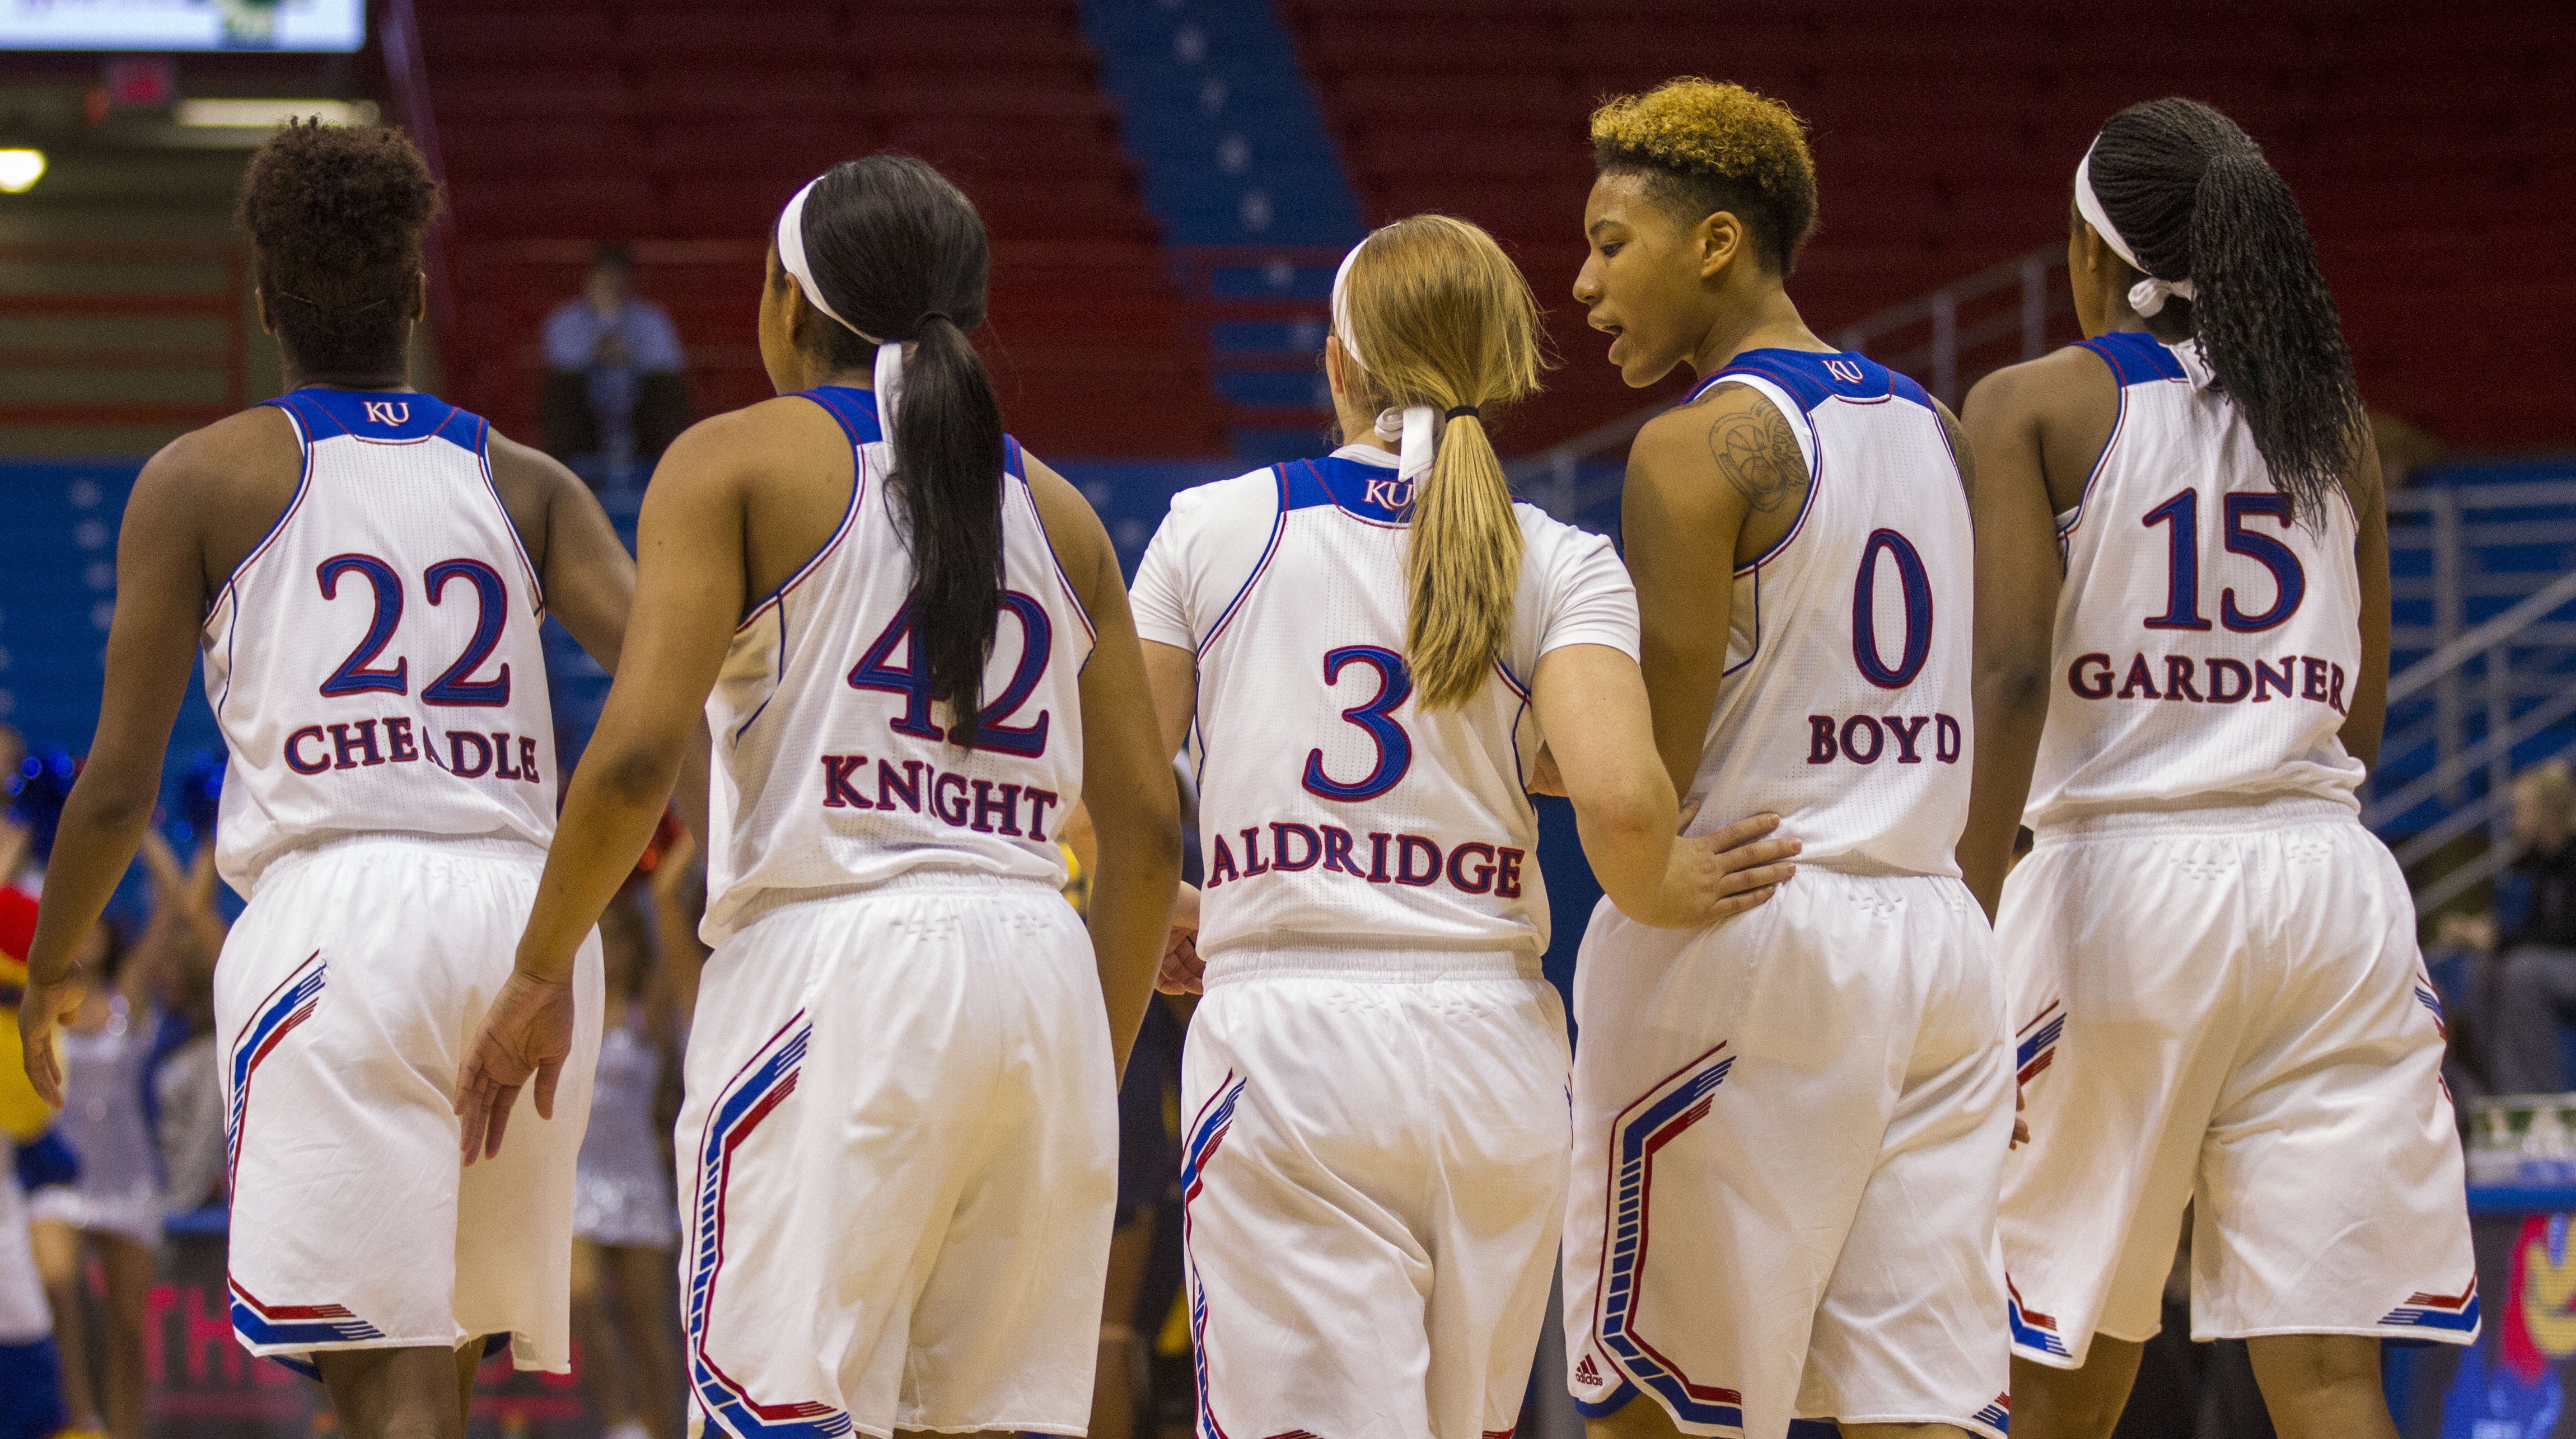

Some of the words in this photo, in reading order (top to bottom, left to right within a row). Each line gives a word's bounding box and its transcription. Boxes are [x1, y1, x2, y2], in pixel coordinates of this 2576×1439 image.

[1820, 359, 1865, 385] KU
[362, 401, 409, 426] KU
[1361, 479, 1413, 512] KU
[2142, 488, 2306, 633] 15
[316, 553, 511, 707] 22
[1853, 528, 1933, 689] 0
[847, 588, 1052, 758] 42
[2068, 653, 2347, 717] GARDNER
[1301, 645, 1413, 802] 3
[1807, 713, 1961, 765] BOYD
[1207, 822, 1526, 899] ALDRIDGE
[1575, 1372, 1603, 1386] adidas
